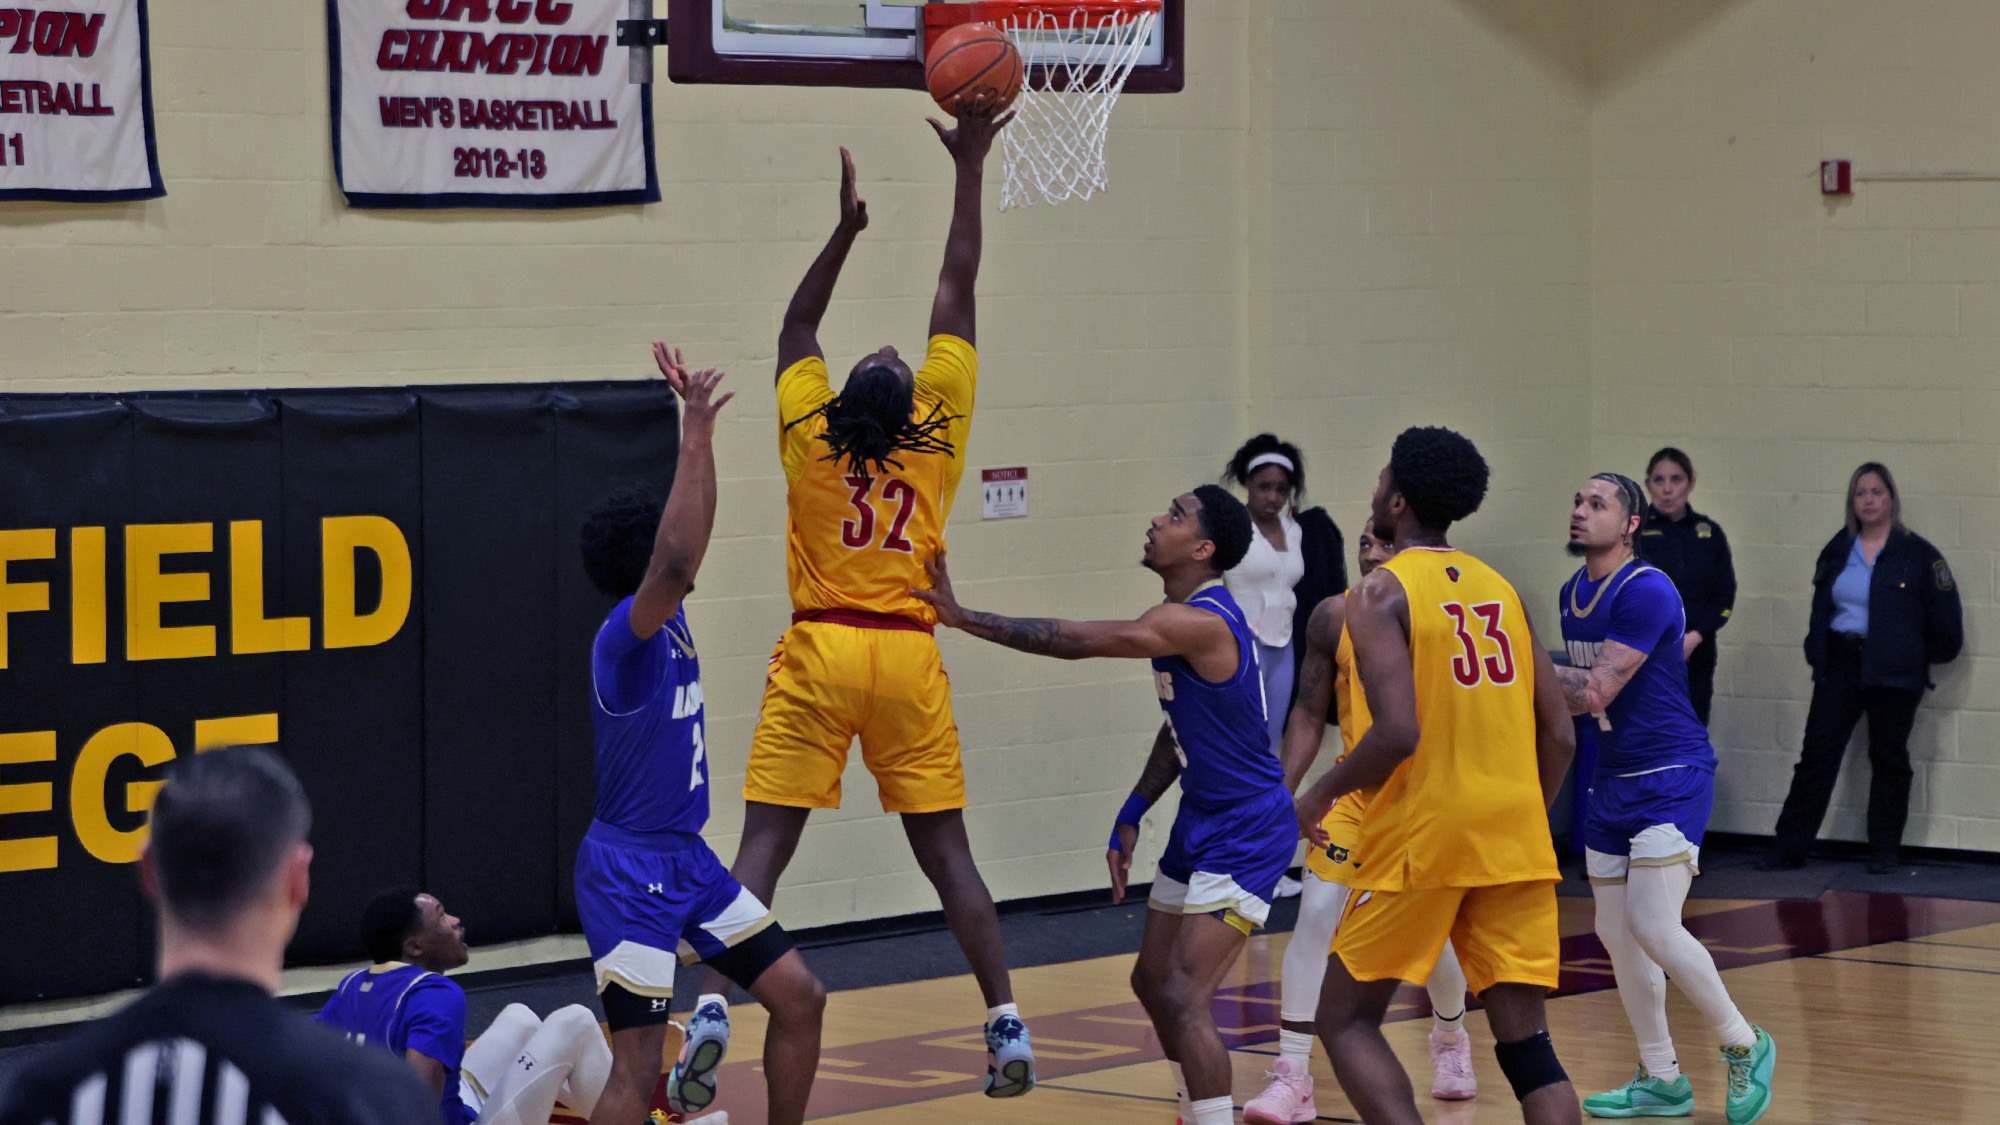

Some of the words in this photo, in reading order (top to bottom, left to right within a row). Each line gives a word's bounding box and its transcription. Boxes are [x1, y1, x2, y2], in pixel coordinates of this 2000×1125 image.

[377, 29, 609, 76] CHAMPION
[379, 96, 455, 128] MEN'S
[459, 98, 618, 131] BASKETBALL
[454, 147, 547, 179] 2012-13
[841, 475, 914, 554] 32
[1440, 601, 1516, 689] 33
[0, 713, 278, 873] EG
